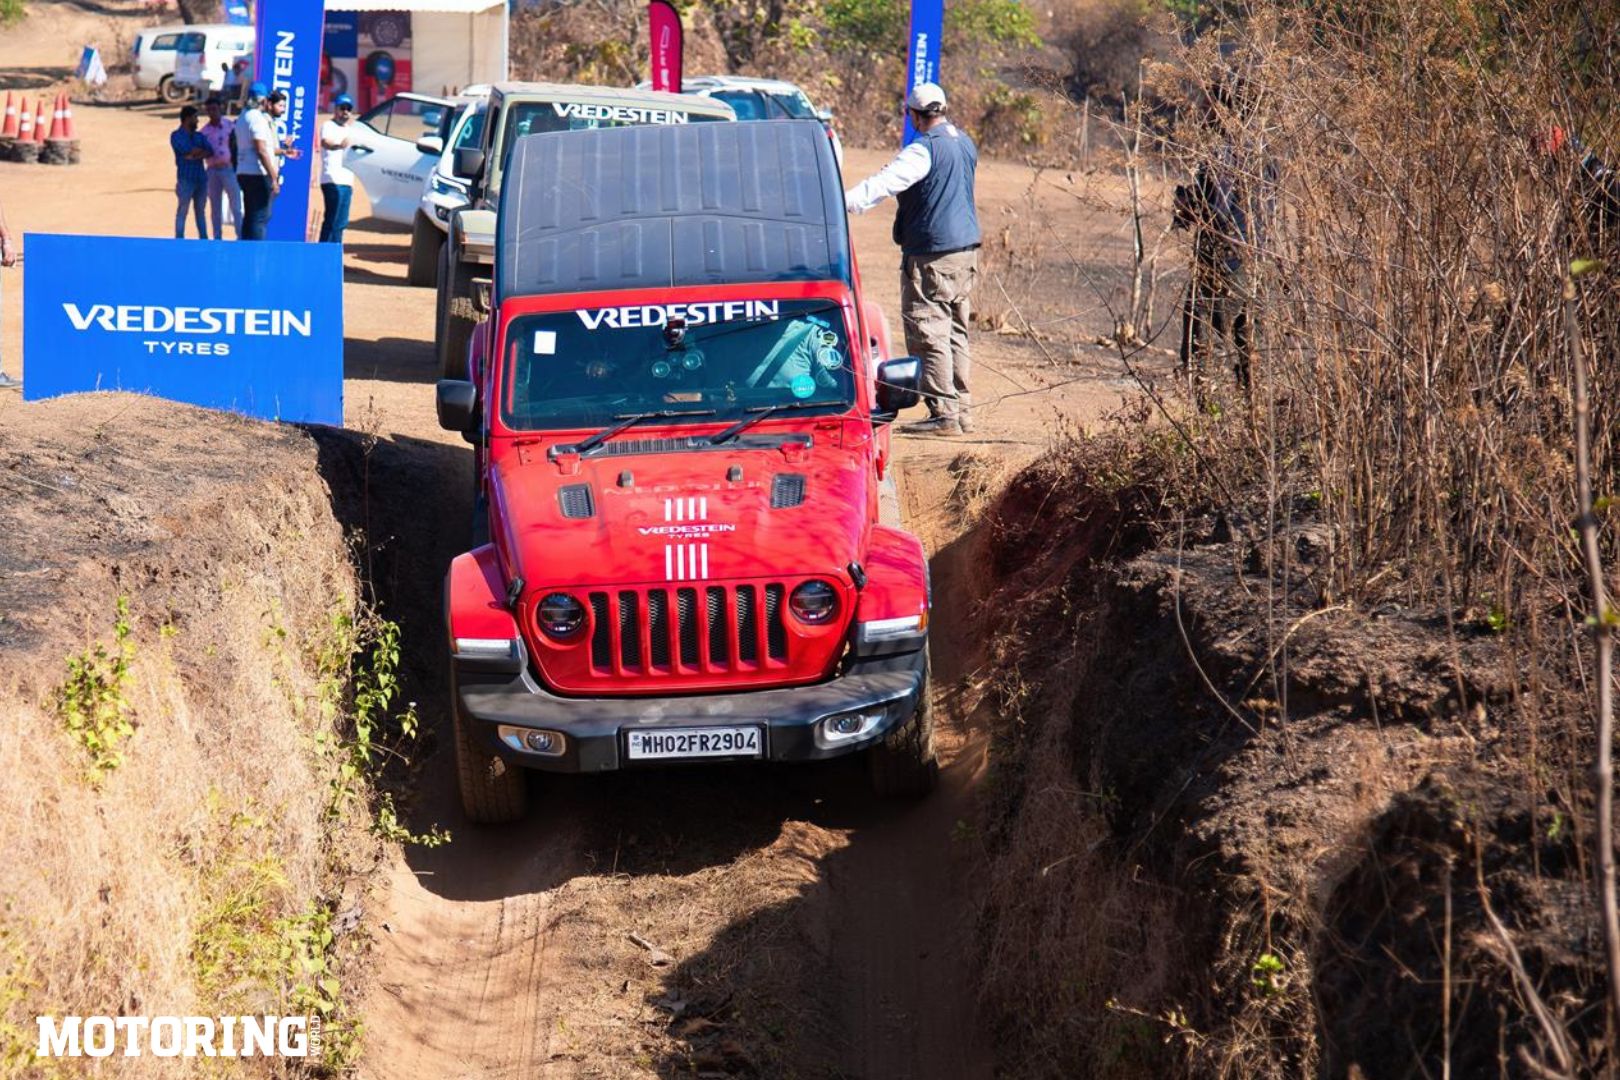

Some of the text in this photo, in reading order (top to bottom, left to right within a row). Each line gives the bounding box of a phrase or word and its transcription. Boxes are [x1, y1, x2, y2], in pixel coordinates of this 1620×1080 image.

[292, 86, 305, 142] TYRES
[552, 102, 688, 124] VREDESTEIN
[62, 303, 311, 336] VREDESTEIN
[576, 300, 779, 330] VREDESTEIN
[143, 341, 230, 356] TYRES
[638, 524, 736, 535] VREDESTEIN
